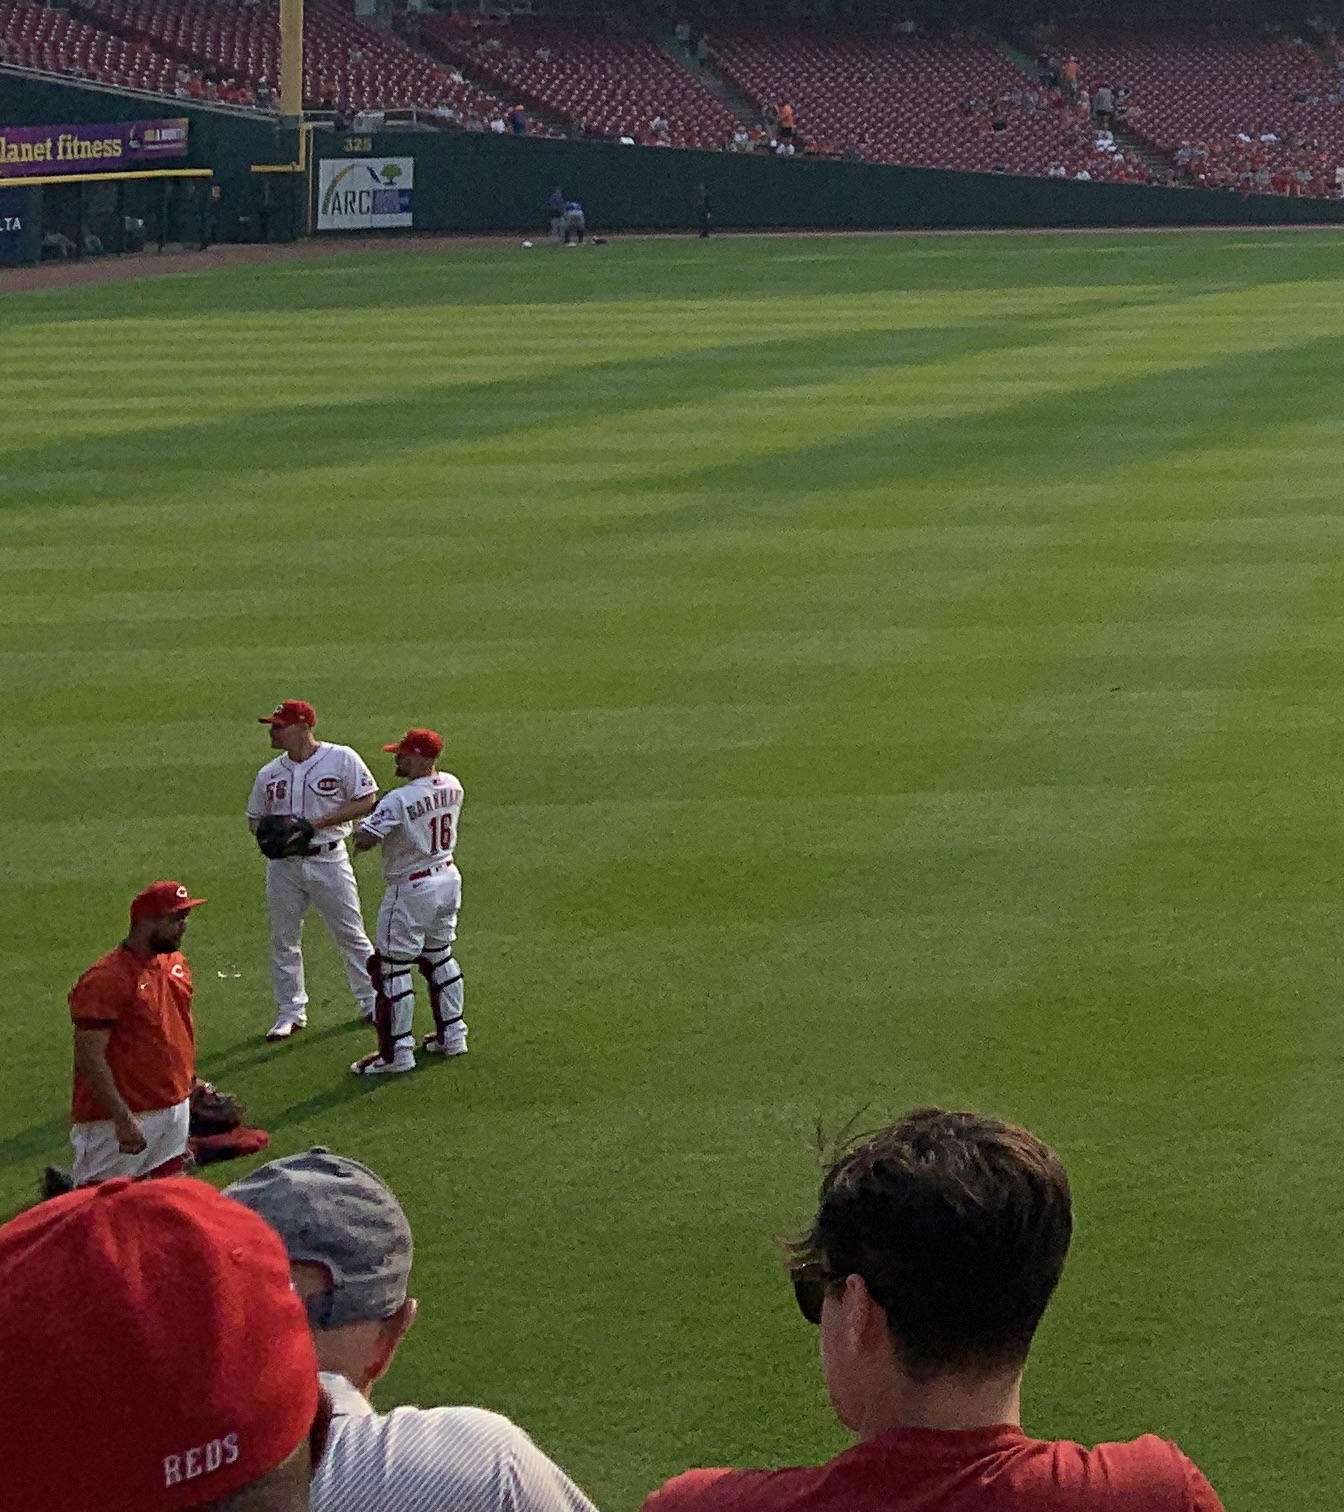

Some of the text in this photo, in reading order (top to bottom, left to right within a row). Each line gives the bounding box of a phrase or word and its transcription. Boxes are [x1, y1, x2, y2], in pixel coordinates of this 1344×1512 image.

[57, 133, 122, 161] fitness
[429, 813, 452, 856] 16
[162, 1432, 240, 1488] REDS
